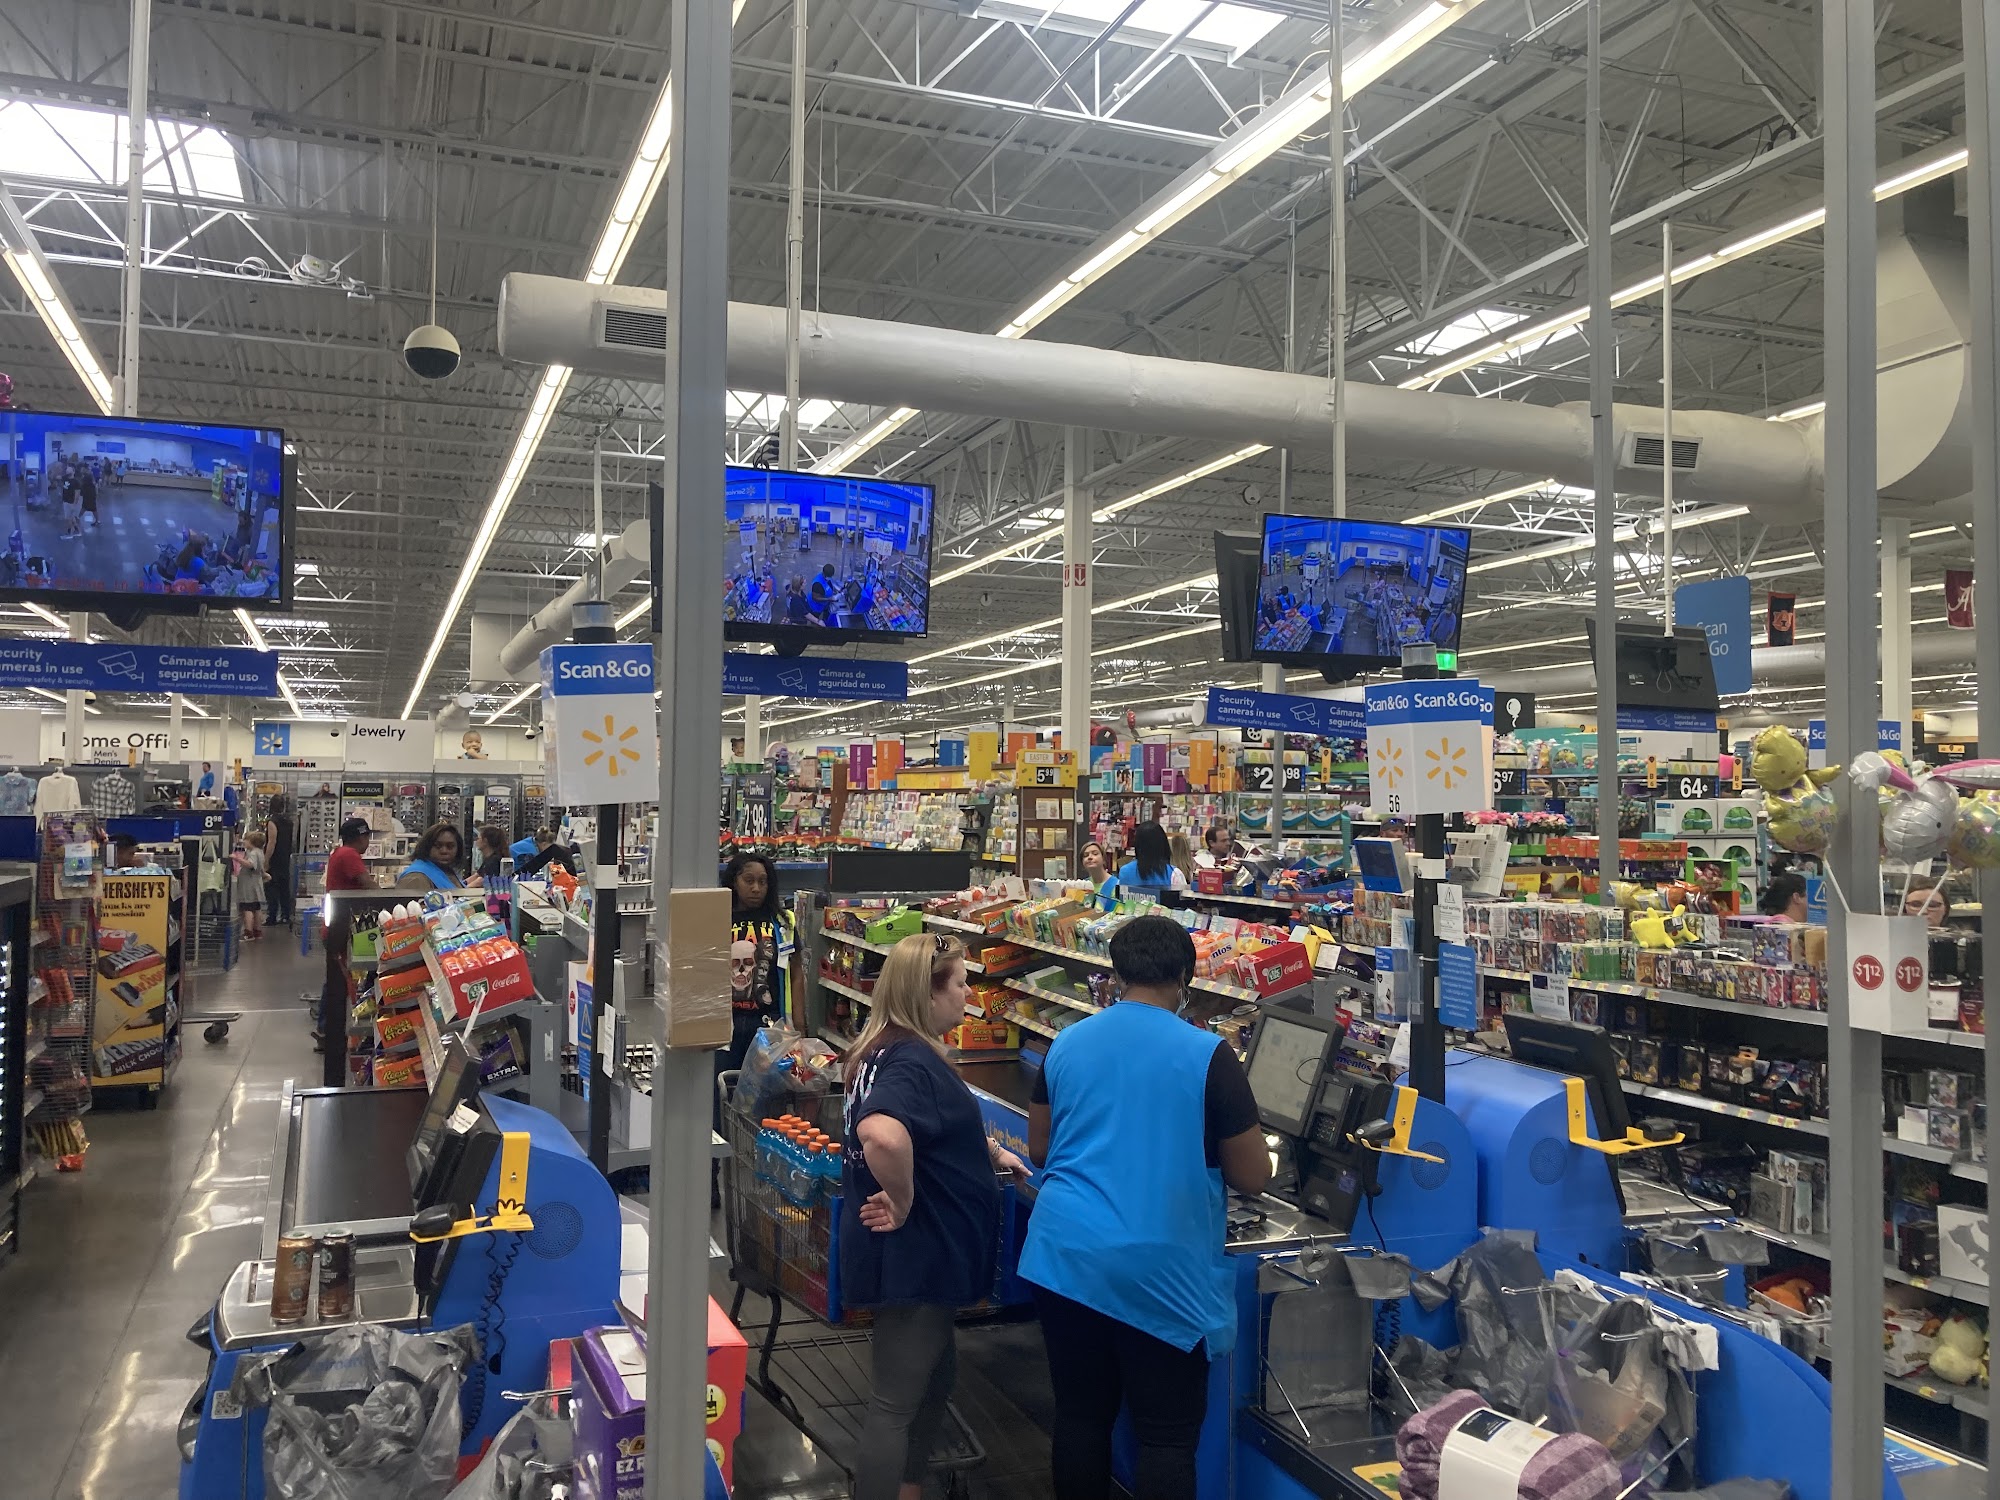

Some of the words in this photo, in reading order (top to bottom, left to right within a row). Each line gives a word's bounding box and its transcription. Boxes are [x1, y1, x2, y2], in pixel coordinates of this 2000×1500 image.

[0, 648, 43, 662] curity
[159, 654, 212, 668] Cámaras
[214, 657, 230, 668] de
[0, 662, 42, 672] meras
[45, 662, 58, 673] in
[61, 665, 84, 675] use
[158, 669, 218, 682] seguridad
[220, 672, 235, 681] en
[238, 673, 259, 682] uso
[560, 660, 652, 680] Scan&Go
[818, 668, 854, 679] Cámaras
[856, 670, 866, 679] de
[729, 673, 738, 682] in
[740, 675, 754, 683] use
[818, 679, 858, 689] seguridad
[872, 682, 886, 690] uso
[1219, 694, 1256, 708] Security
[1367, 694, 1409, 713] Scan&Go
[1414, 692, 1479, 709] Scan&Go
[1218, 707, 1254, 717] cameras
[1256, 709, 1265, 717] in
[1266, 711, 1281, 719] use
[1330, 706, 1364, 718] Cámaras
[1226, 716, 1248, 724] prioritize
[1249, 718, 1263, 726] safety
[351, 724, 406, 741] Jewelry
[62, 732, 121, 748] ome
[127, 733, 190, 749] Offie
[279, 759, 316, 769] IRONMAN
[1029, 753, 1049, 761] EASTER
[1389, 794, 1400, 813] 56
[112, 910, 146, 918] session
[733, 921, 754, 929] ACK
[731, 925, 774, 945] TAN
[1212, 943, 1232, 959] ntos
[1337, 965, 1359, 977] EXTRA
[991, 1002, 1008, 1014] STIC
[385, 1023, 413, 1041] STICKS
[115, 1059, 138, 1074] MILK
[487, 1065, 518, 1081] EXTRA
[989, 1119, 1004, 1141] Live
[616, 1458, 634, 1475] EZ
